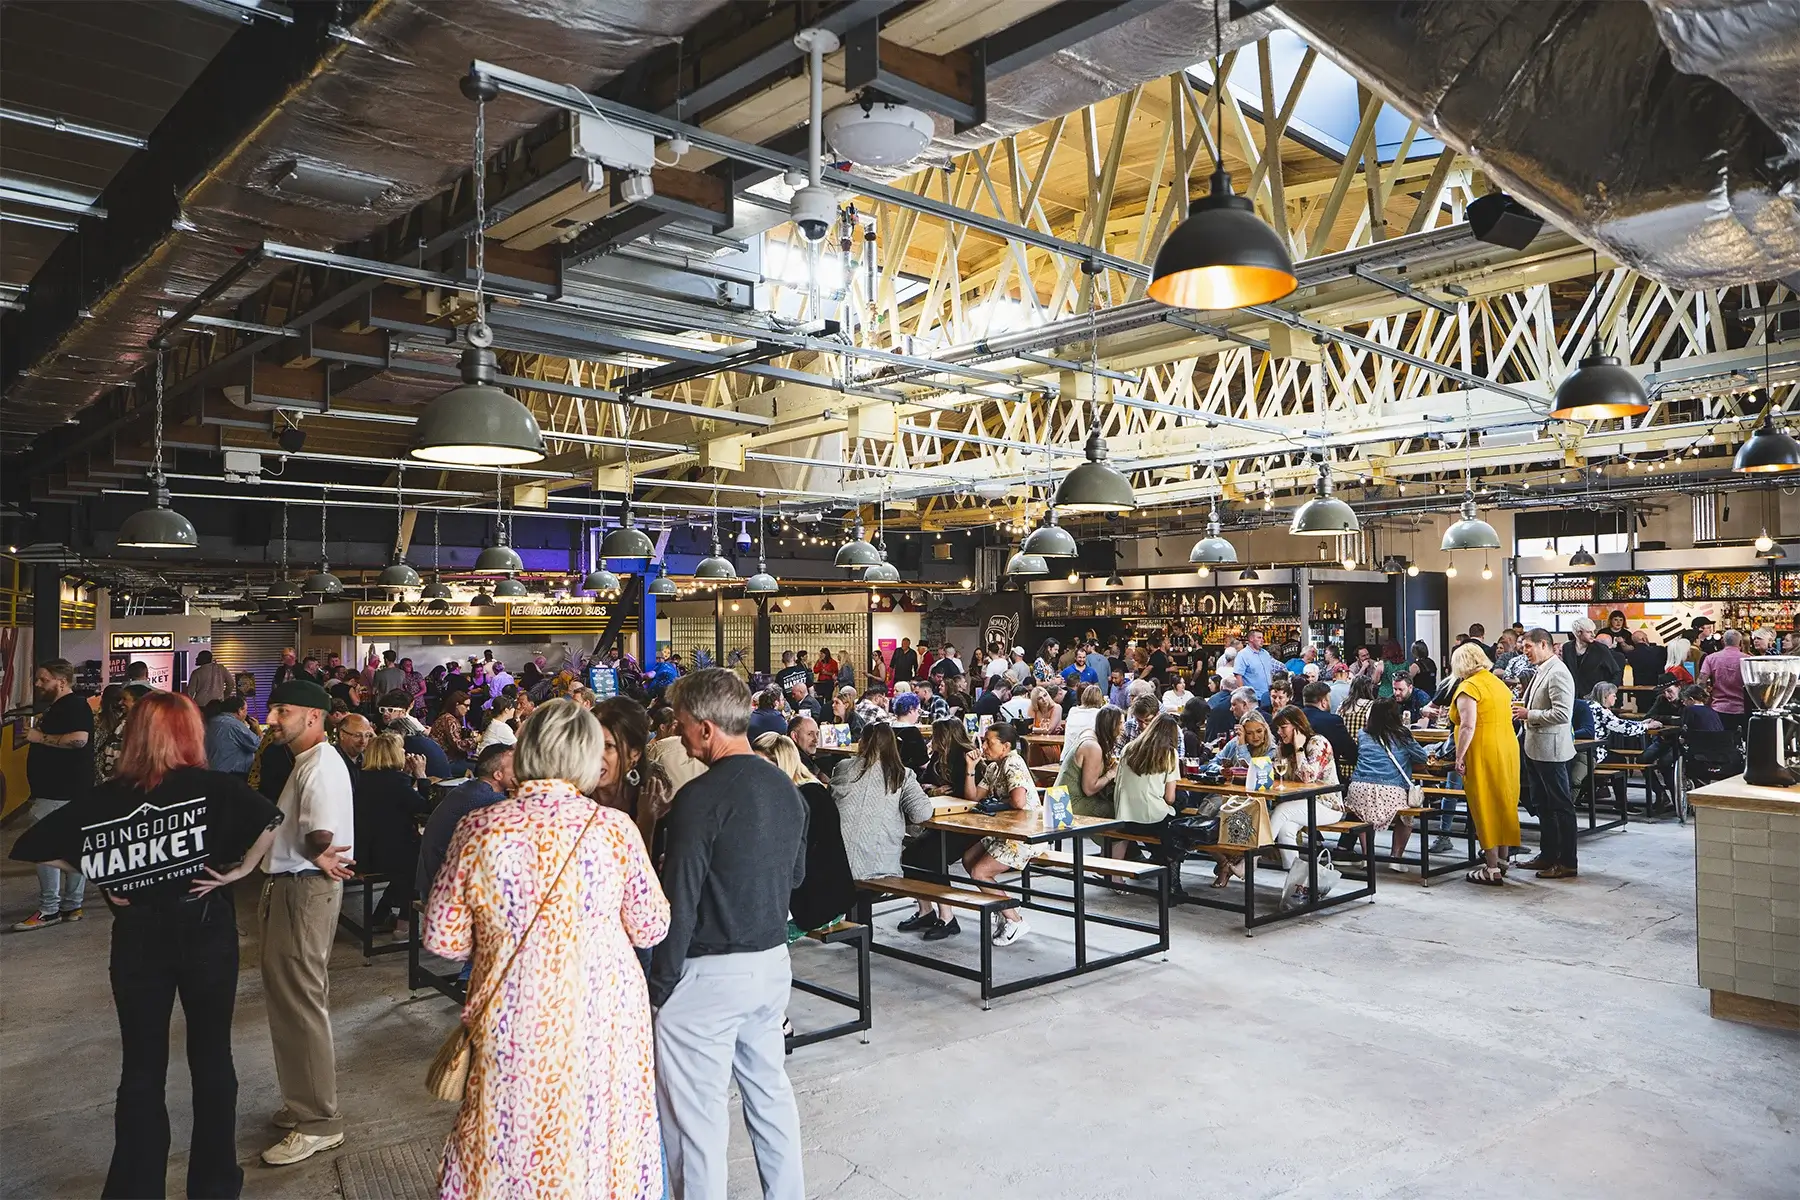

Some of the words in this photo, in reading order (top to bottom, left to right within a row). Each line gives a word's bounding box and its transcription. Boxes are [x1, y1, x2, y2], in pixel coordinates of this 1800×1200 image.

[511, 606, 582, 615] NEIGHBOURHOOD
[585, 606, 607, 615] SUBS
[770, 623, 794, 634] NGDON
[795, 623, 823, 634] STREET
[825, 623, 856, 634] MARKET
[114, 636, 171, 648] PHOTOS
[109, 665, 126, 673] MILE
[82, 809, 196, 853] ABINGDON
[81, 825, 207, 880] MARKET
[122, 877, 155, 892] RETAIL
[167, 862, 205, 880] EVENTS
